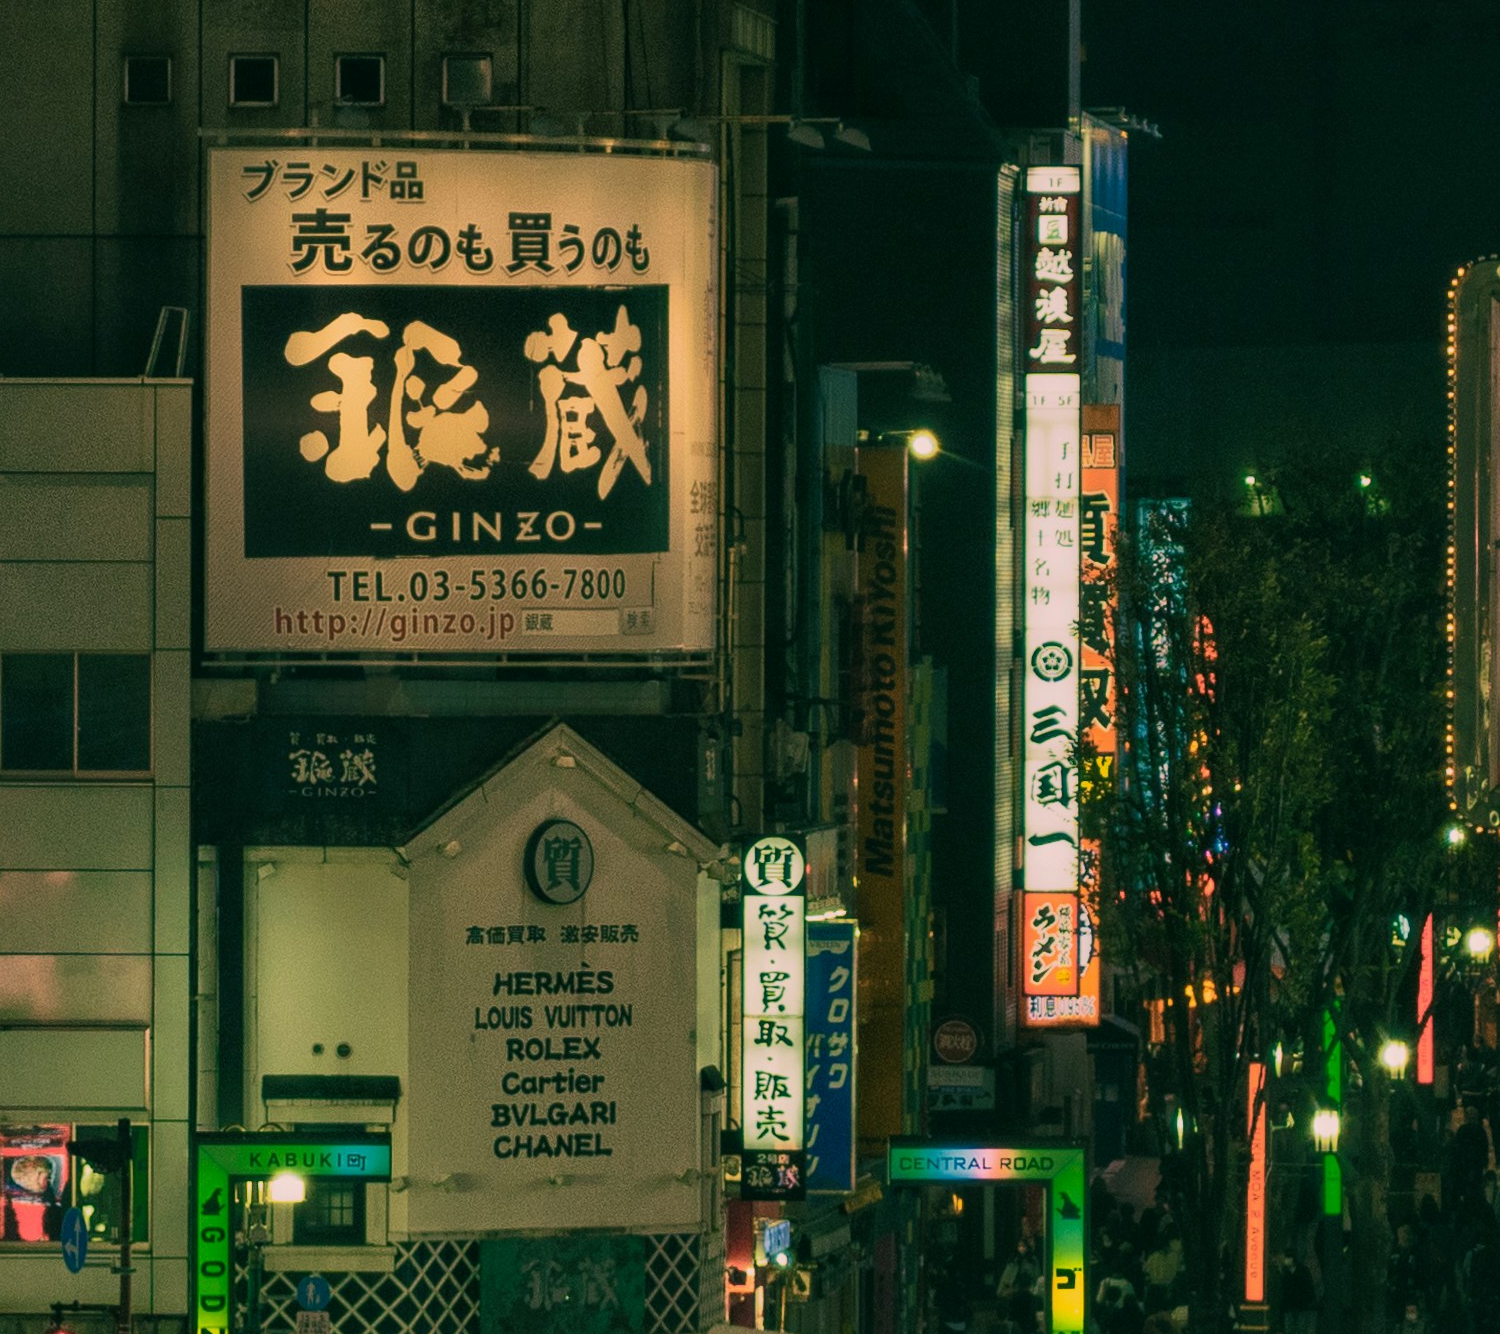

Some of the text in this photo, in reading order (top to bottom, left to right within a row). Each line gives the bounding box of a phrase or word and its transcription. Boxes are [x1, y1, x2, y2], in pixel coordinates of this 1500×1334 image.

[242, 160, 426, 201] ブランド品
[291, 208, 651, 273] 売るのも 買うのも
[284, 304, 652, 501] 銀蔵
[274, 607, 516, 641] http://ginzo.jp
[865, 653, 897, 877] Matsumoto
[1028, 703, 1078, 849] 三国一
[465, 924, 639, 946] 高価買取 激安販売
[1032, 903, 1056, 984] ラーメン
[492, 962, 615, 996] HERMÈS
[474, 1003, 633, 1030] LOUIS VUITTON
[828, 965, 851, 1089] クロサワ
[506, 1037, 601, 1062] ROLEX
[501, 1068, 605, 1095] Cartier
[491, 1101, 617, 1127] BVLGARI
[493, 1134, 612, 1159] CHANEL
[899, 1155, 1055, 1172] CENTRAL ROAD
